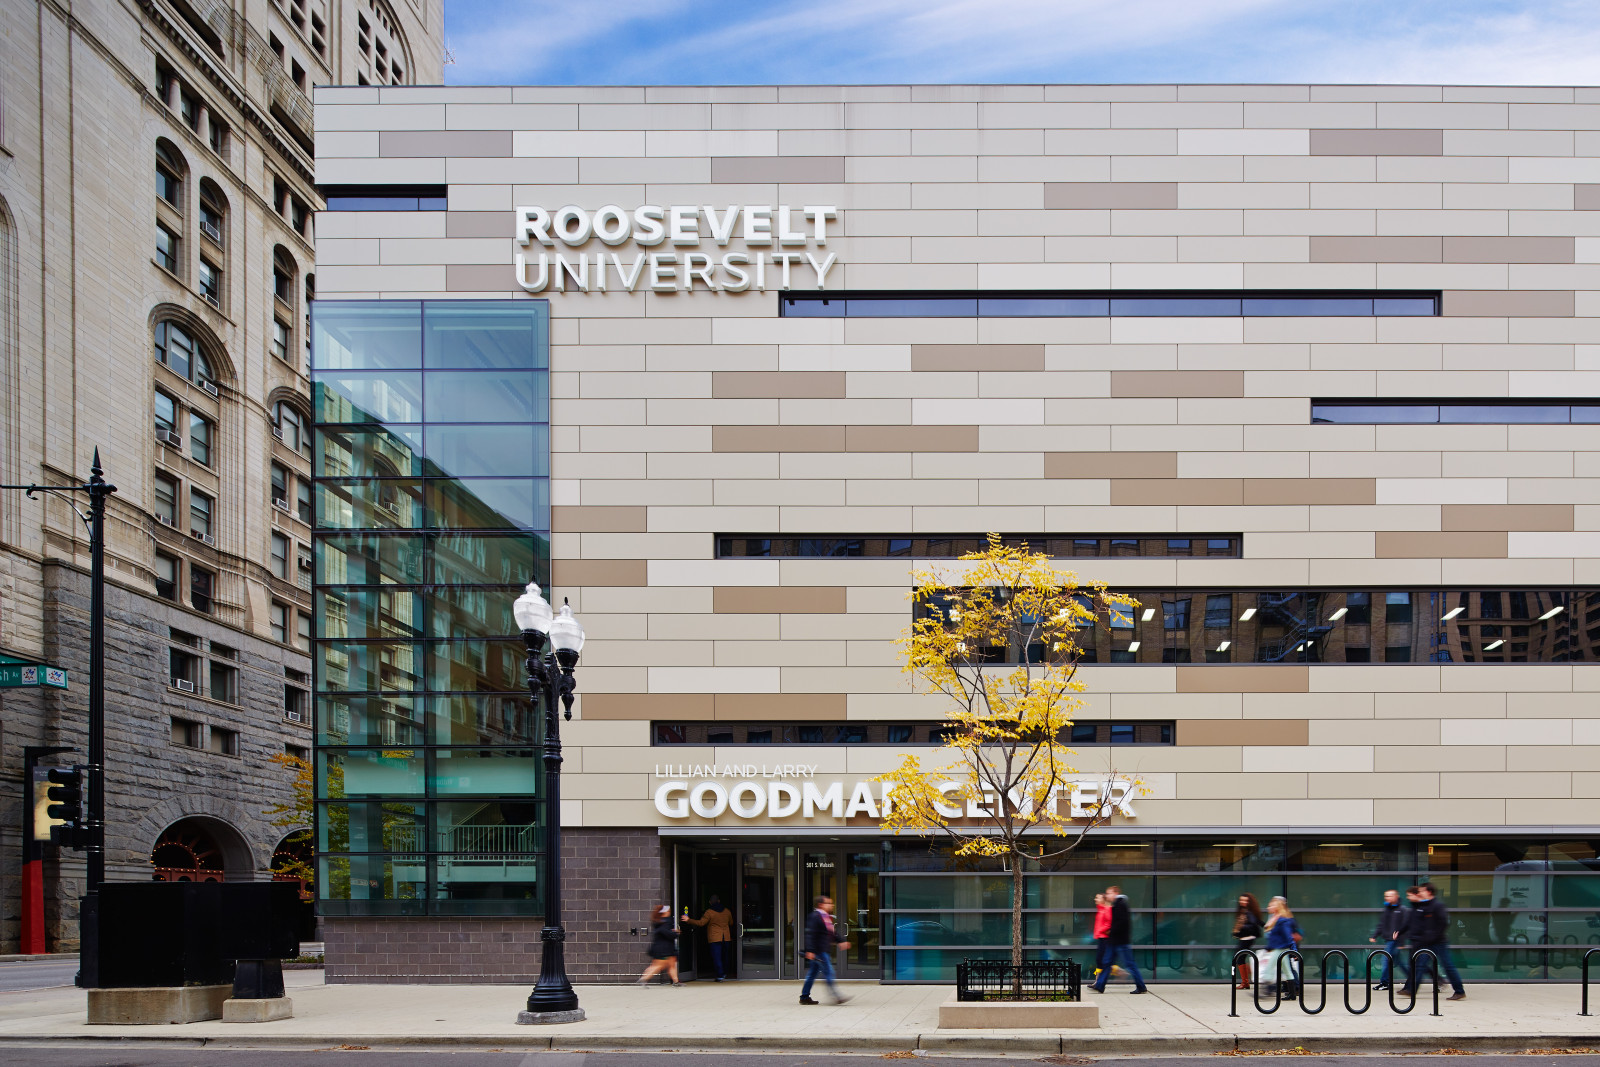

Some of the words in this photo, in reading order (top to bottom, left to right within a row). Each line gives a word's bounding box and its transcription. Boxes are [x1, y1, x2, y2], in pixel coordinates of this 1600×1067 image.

[515, 204, 837, 246] ROOSEVELT
[515, 252, 837, 293] UNIVERSITY
[655, 764, 716, 778] LILLIAN
[722, 764, 758, 778] AND
[763, 764, 818, 778] LARRY
[931, 780, 1137, 819] CENTER
